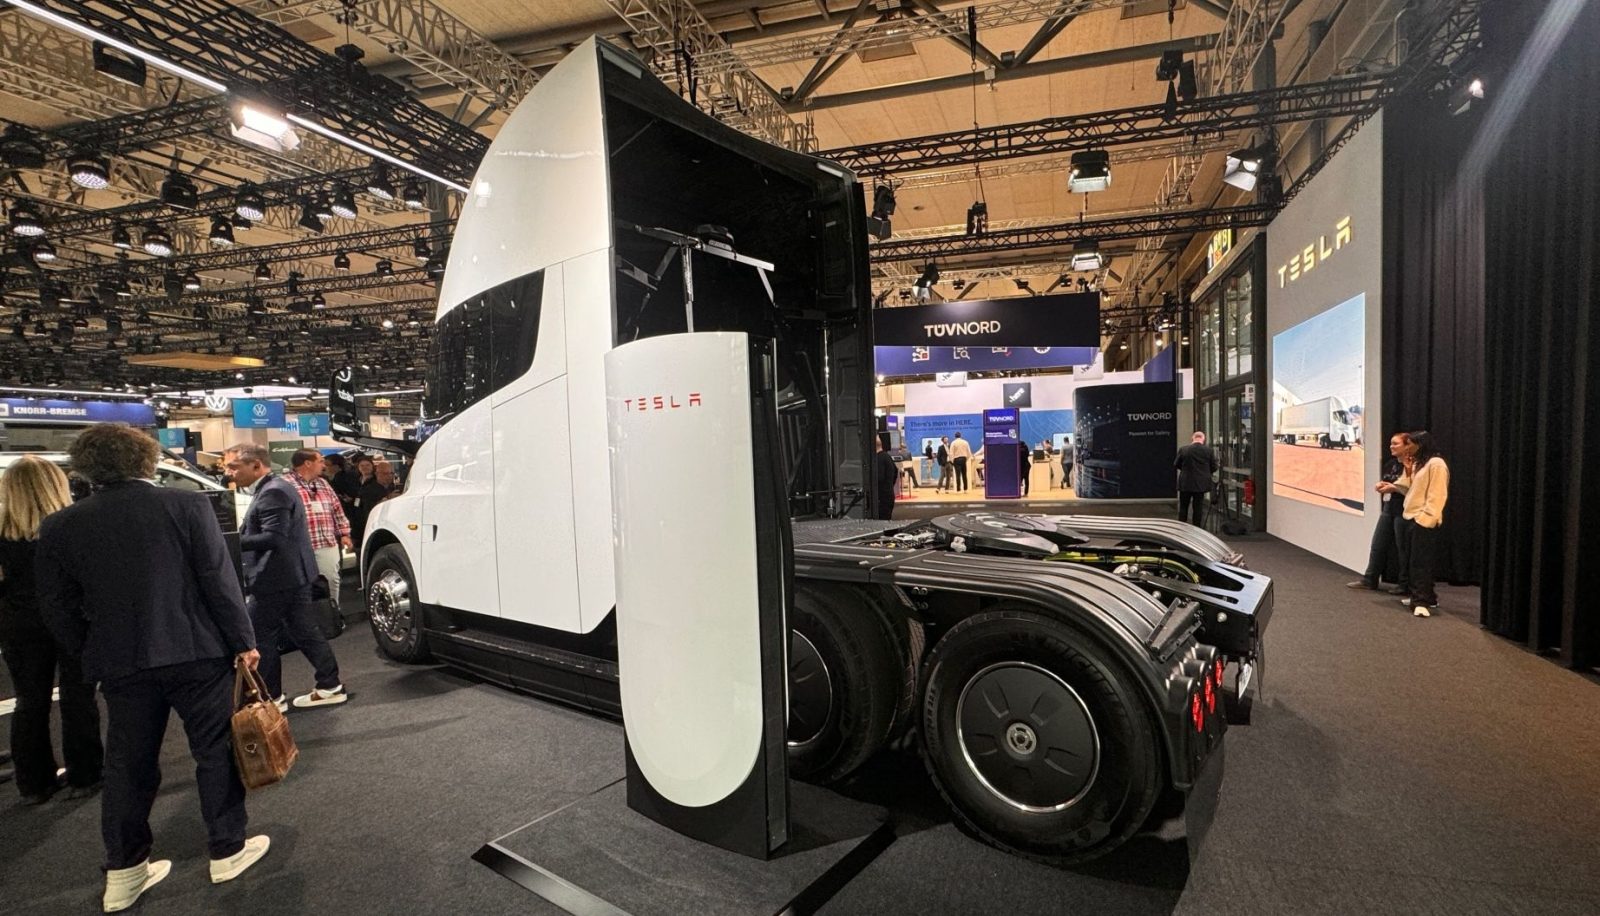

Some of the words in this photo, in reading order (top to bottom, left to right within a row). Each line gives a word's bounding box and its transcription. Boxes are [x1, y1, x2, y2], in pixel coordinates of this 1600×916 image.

[1278, 216, 1351, 288] TESLA
[924, 321, 1001, 337] TÜVNORD
[625, 393, 701, 412] TESLA
[13, 407, 87, 416] KNORR-BREMSE
